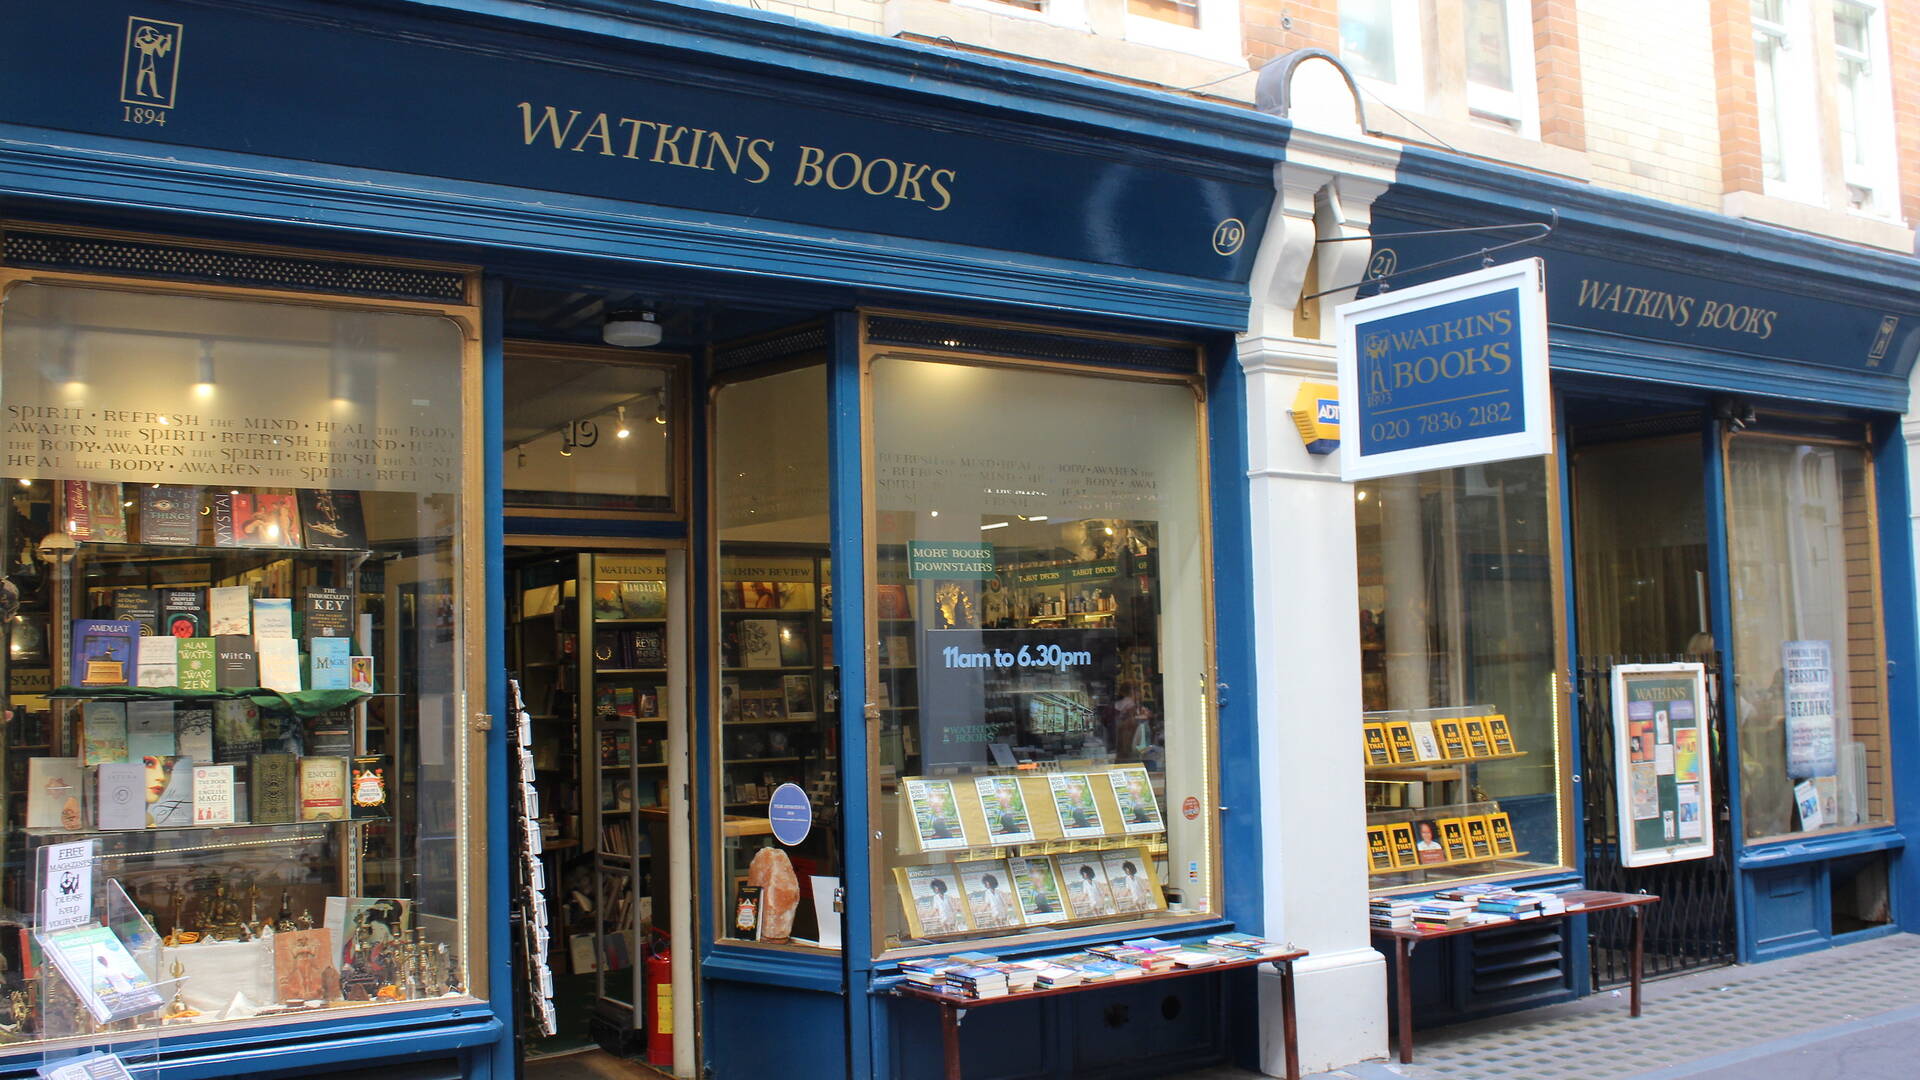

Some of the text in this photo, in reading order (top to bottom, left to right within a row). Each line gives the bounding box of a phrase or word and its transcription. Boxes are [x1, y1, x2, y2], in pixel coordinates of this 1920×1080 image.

[123, 106, 166, 126] 1894
[517, 101, 956, 211] WATKINS BOOKS
[1217, 227, 1241, 247] 19
[1373, 255, 1393, 275] 21
[1577, 279, 1778, 340] WATKINS BOOKS
[1391, 310, 1513, 352] WATKINS
[1392, 342, 1512, 388] BOOKS
[7, 405, 84, 427] SPIRIT
[104, 410, 200, 426] REFRSH
[209, 418, 236, 428] THE
[245, 417, 299, 431] MIND
[1319, 405, 1340, 420] ADT
[1371, 402, 1512, 442] 020 7836 2182
[7, 422, 97, 437] AWAKEN
[104, 429, 131, 439] THE
[138, 428, 207, 448] SPIRIT
[221, 432, 309, 447] REFRESH
[346, 439, 398, 451] MIND
[568, 421, 598, 447] 19
[8, 441, 33, 450] THE
[40, 439, 97, 452] BODY
[101, 443, 184, 456] AWAKEN
[220, 448, 283, 464] SPIRIT
[8, 454, 64, 467] HEAL
[75, 460, 101, 470] THE
[110, 459, 164, 472] BODY
[178, 462, 260, 476] AWAKEN
[268, 468, 293, 478] THE
[913, 548, 991, 559] MORE BOOKS
[600, 566, 653, 575] WATKINS
[768, 567, 810, 577] REVIEW
[915, 562, 993, 573] DOWNSTAIRS
[314, 600, 345, 611] KEY
[179, 649, 213, 660] WATTS
[184, 641, 208, 649] ALAN
[942, 644, 1091, 671] 11am to 6.30pm
[183, 680, 211, 690] ZEN
[1634, 687, 1687, 700] WATKINS
[58, 846, 85, 859] FREE
[50, 860, 93, 871] MAGAZINES
